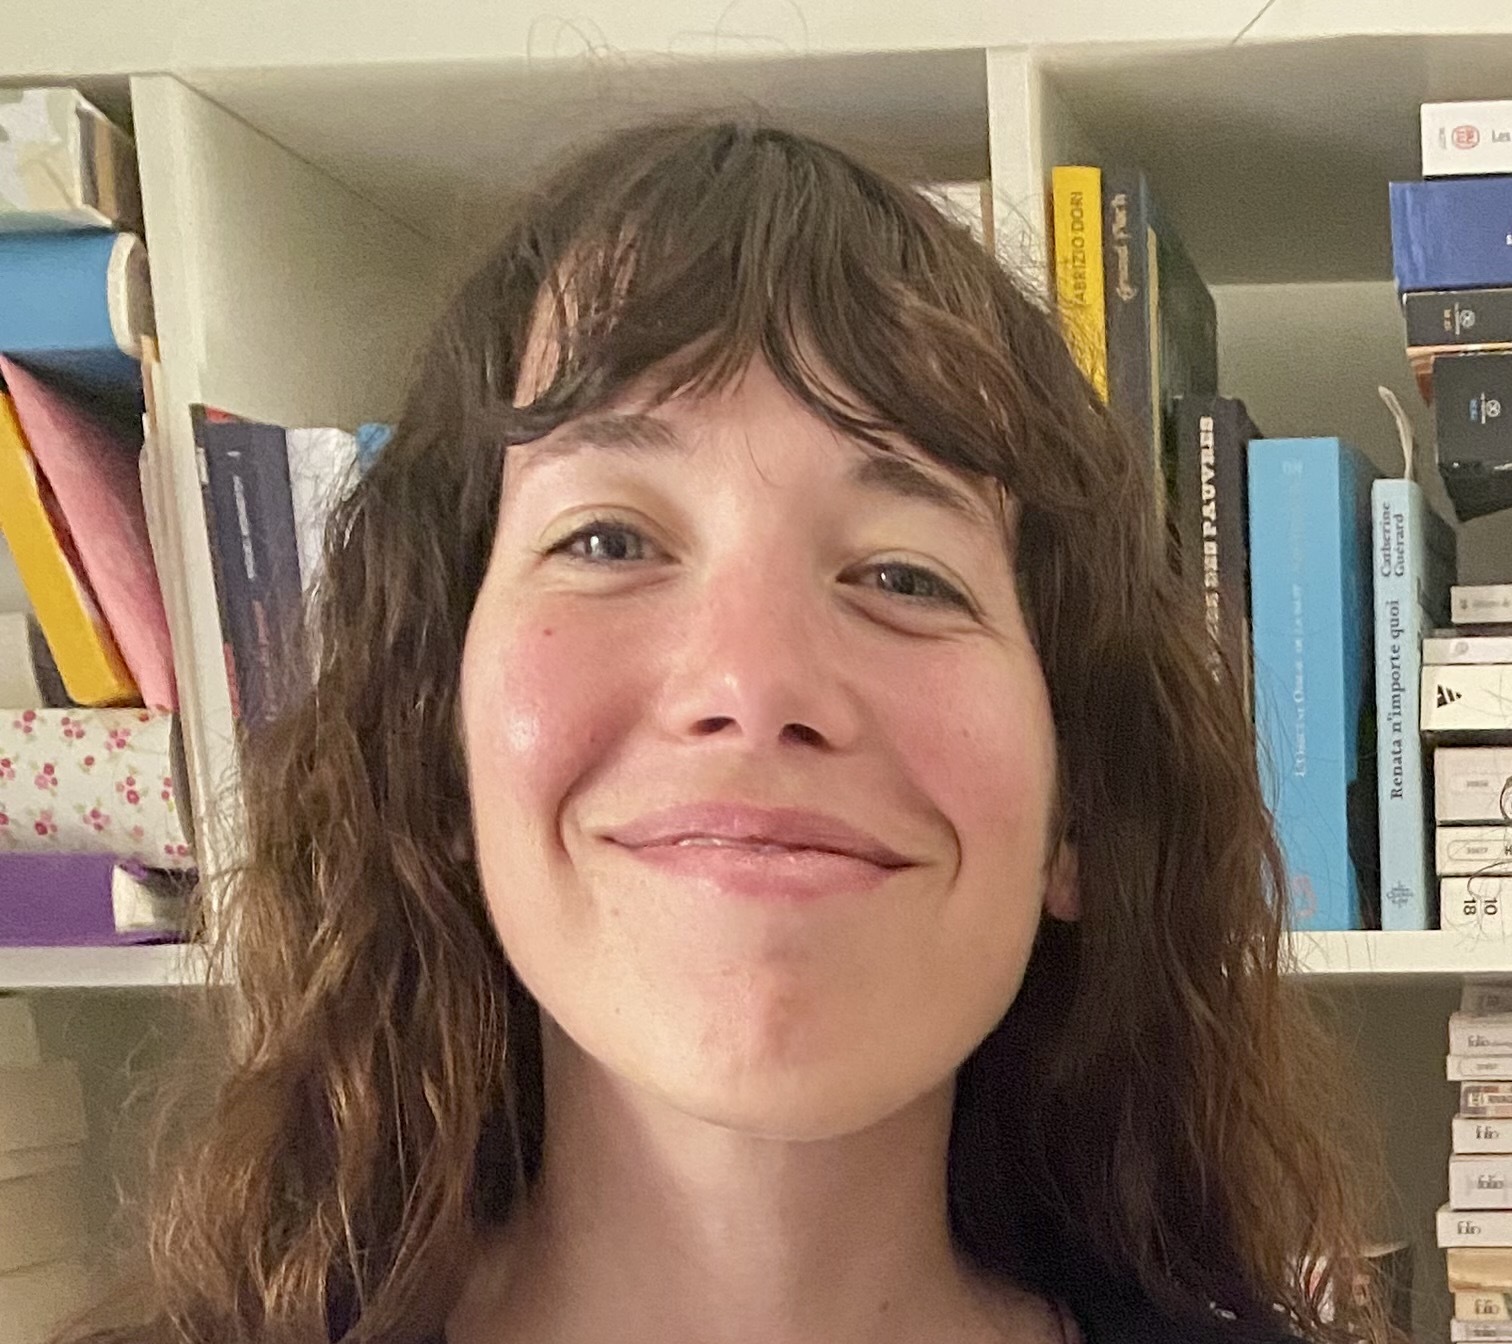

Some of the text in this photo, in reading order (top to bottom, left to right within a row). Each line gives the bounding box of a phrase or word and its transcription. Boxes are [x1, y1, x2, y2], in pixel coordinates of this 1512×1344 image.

[1388, 599, 1405, 801] Renata n'importe quoi
